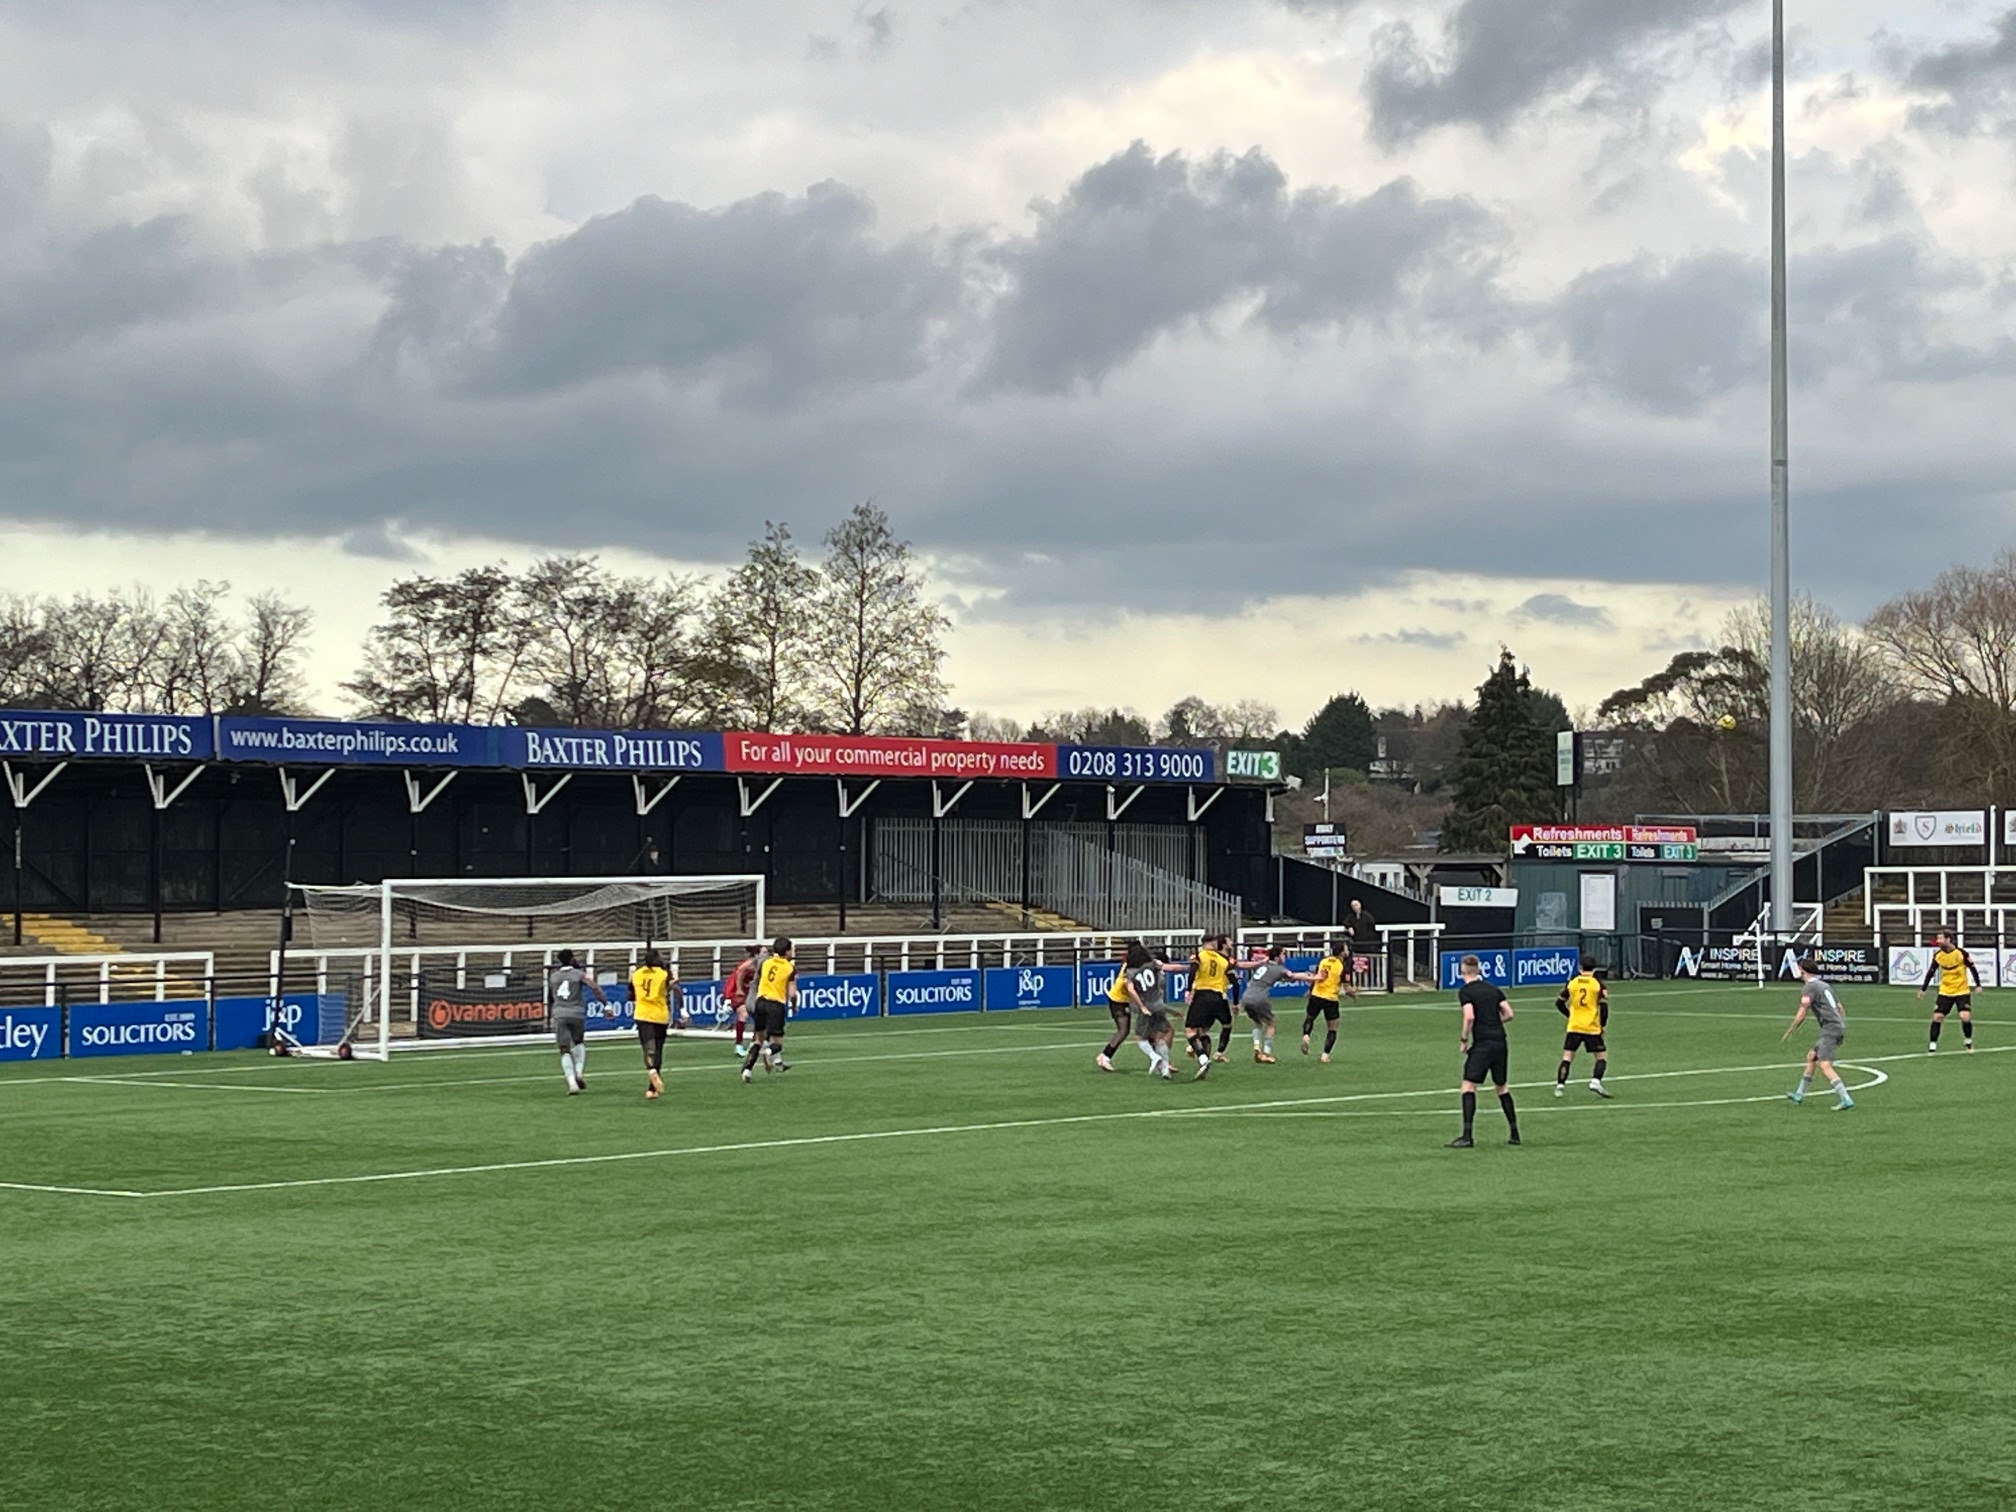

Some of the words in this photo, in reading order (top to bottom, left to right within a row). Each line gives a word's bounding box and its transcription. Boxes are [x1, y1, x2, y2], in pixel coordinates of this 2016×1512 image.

[0, 720, 77, 752] XTER
[83, 717, 192, 755] PHILIPS
[230, 727, 458, 757] www.baxterphilips.co.uk
[526, 732, 606, 765] BAXTER
[614, 735, 702, 767] PHILIPS
[740, 741, 767, 761] For
[772, 742, 790, 763] all
[795, 748, 830, 767] your
[835, 747, 927, 767] commercial
[931, 751, 996, 774] property
[1000, 750, 1044, 771] needs
[1069, 751, 1116, 776] 0208
[1122, 753, 1154, 777] 313
[1160, 754, 1203, 777] 9000
[1227, 751, 1261, 776] EXIT
[1532, 827, 1622, 840] Refreshments
[1631, 829, 1688, 842] Refreshments
[1536, 845, 1572, 858] Toilets
[1576, 845, 1610, 858] EXIT
[1612, 845, 1622, 858] 3
[1631, 846, 1654, 857] Toilets
[1664, 845, 1684, 859] EXIT
[1686, 846, 1692, 859] 3
[1458, 888, 1481, 901] EXIT
[1485, 889, 1491, 902] 2
[1710, 948, 1758, 961] INSPIRE
[1814, 950, 1866, 963] INSPIRE
[768, 965, 777, 983] 6
[1253, 966, 1267, 980] 9
[1449, 956, 1491, 987] jue
[1495, 954, 1506, 978] &
[1517, 952, 1575, 984] priestley
[557, 980, 570, 999] 4
[643, 979, 652, 998] 4
[1017, 969, 1044, 997] j&p
[1134, 968, 1156, 992] 10
[896, 985, 972, 1005] SOLICITORS
[1579, 988, 1587, 1006] 2
[451, 1002, 544, 1022] vanarama
[587, 1001, 621, 1018] 820
[81, 1022, 195, 1047] SOLICITORS
